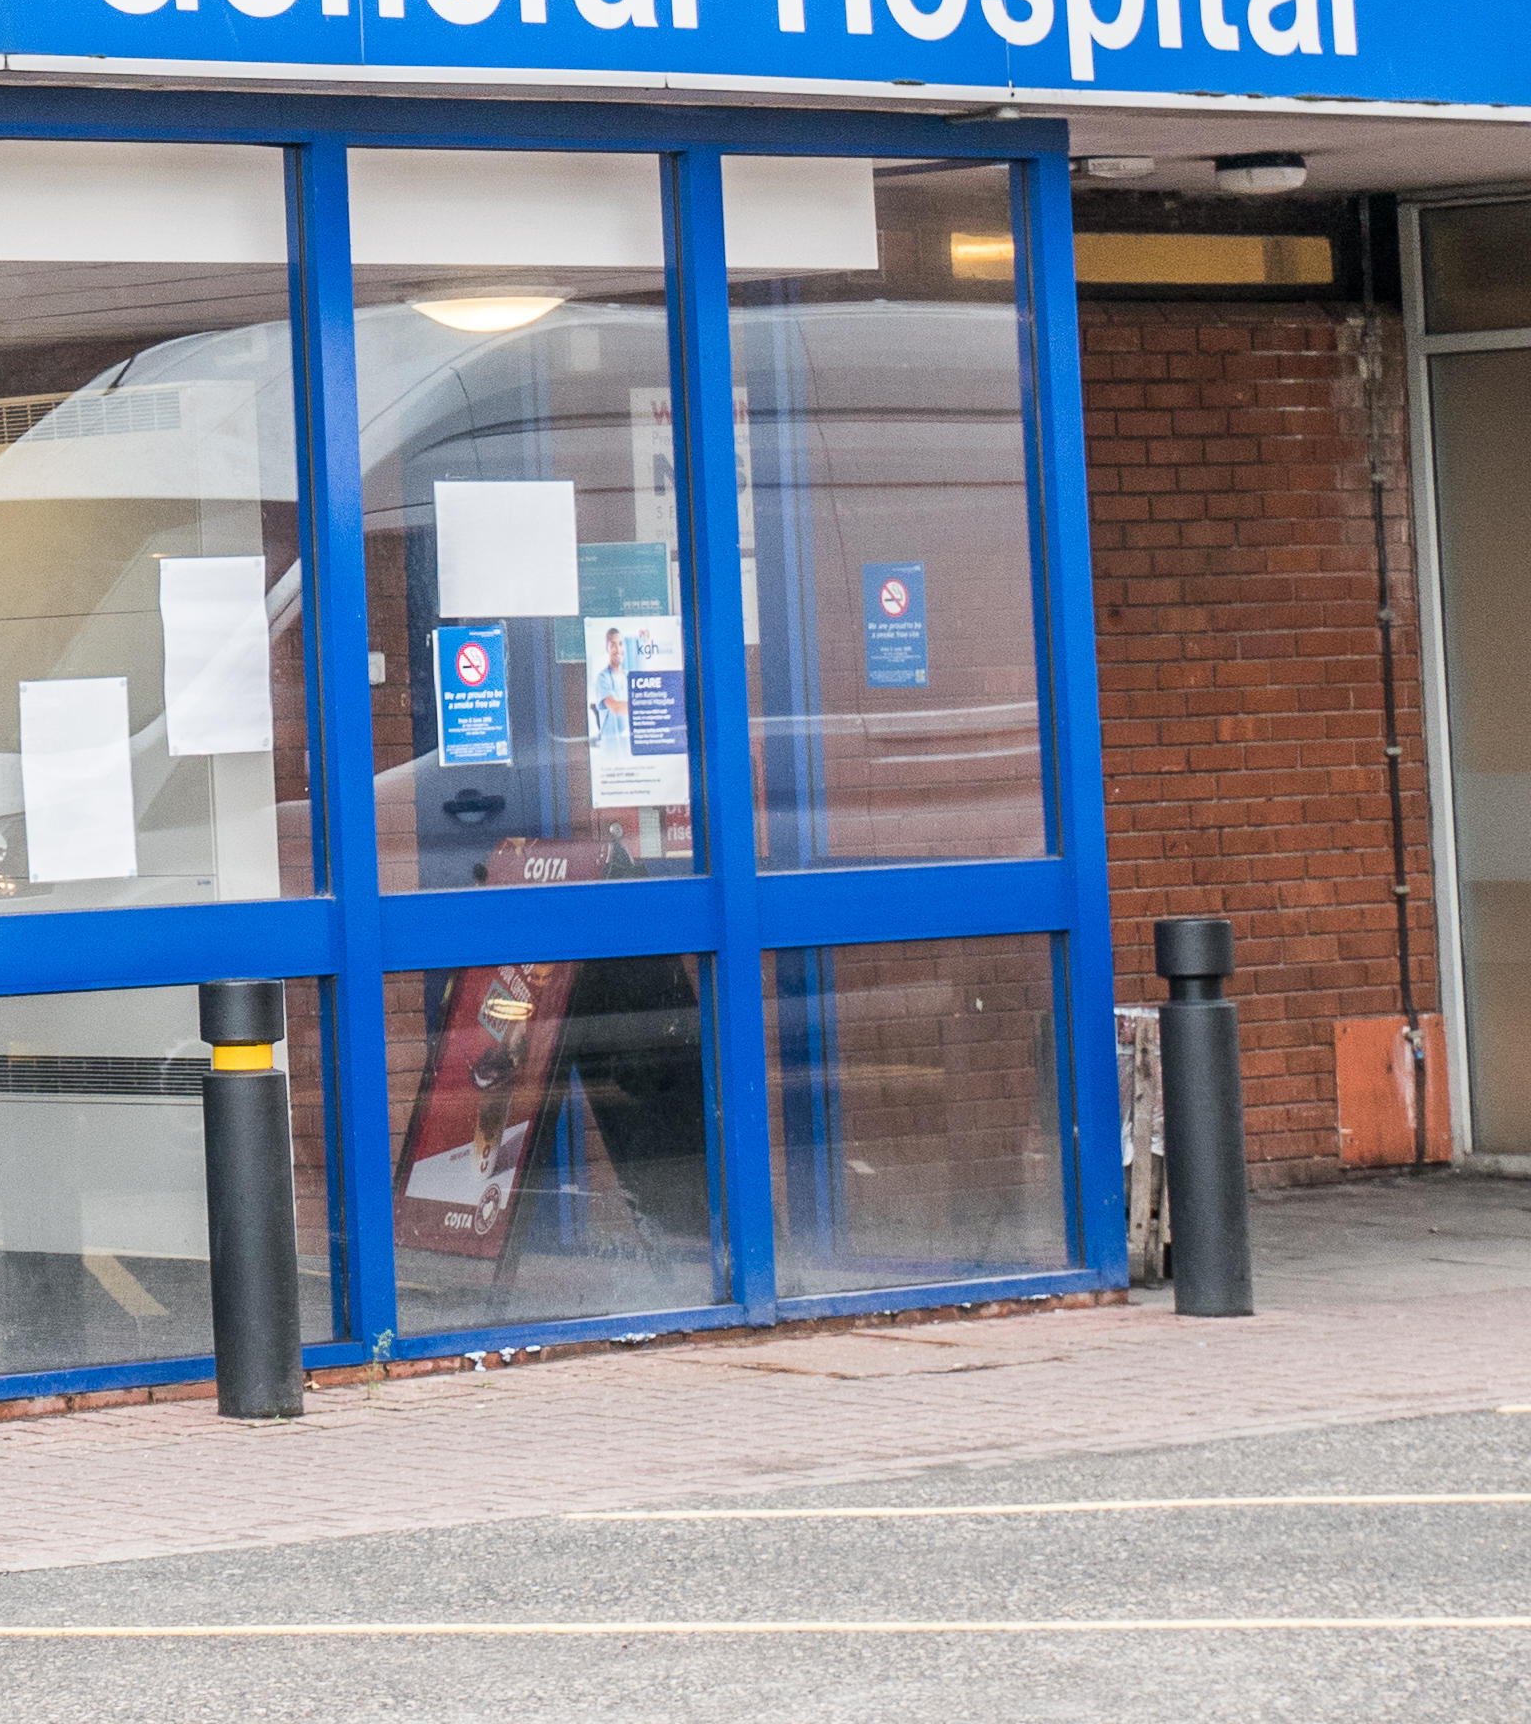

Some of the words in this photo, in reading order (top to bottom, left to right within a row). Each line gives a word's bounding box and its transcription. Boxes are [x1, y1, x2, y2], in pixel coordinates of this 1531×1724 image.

[636, 639, 659, 660] kgh
[636, 676, 662, 689] CARE
[523, 856, 568, 882] COSTA
[444, 1211, 473, 1230] COSTA
